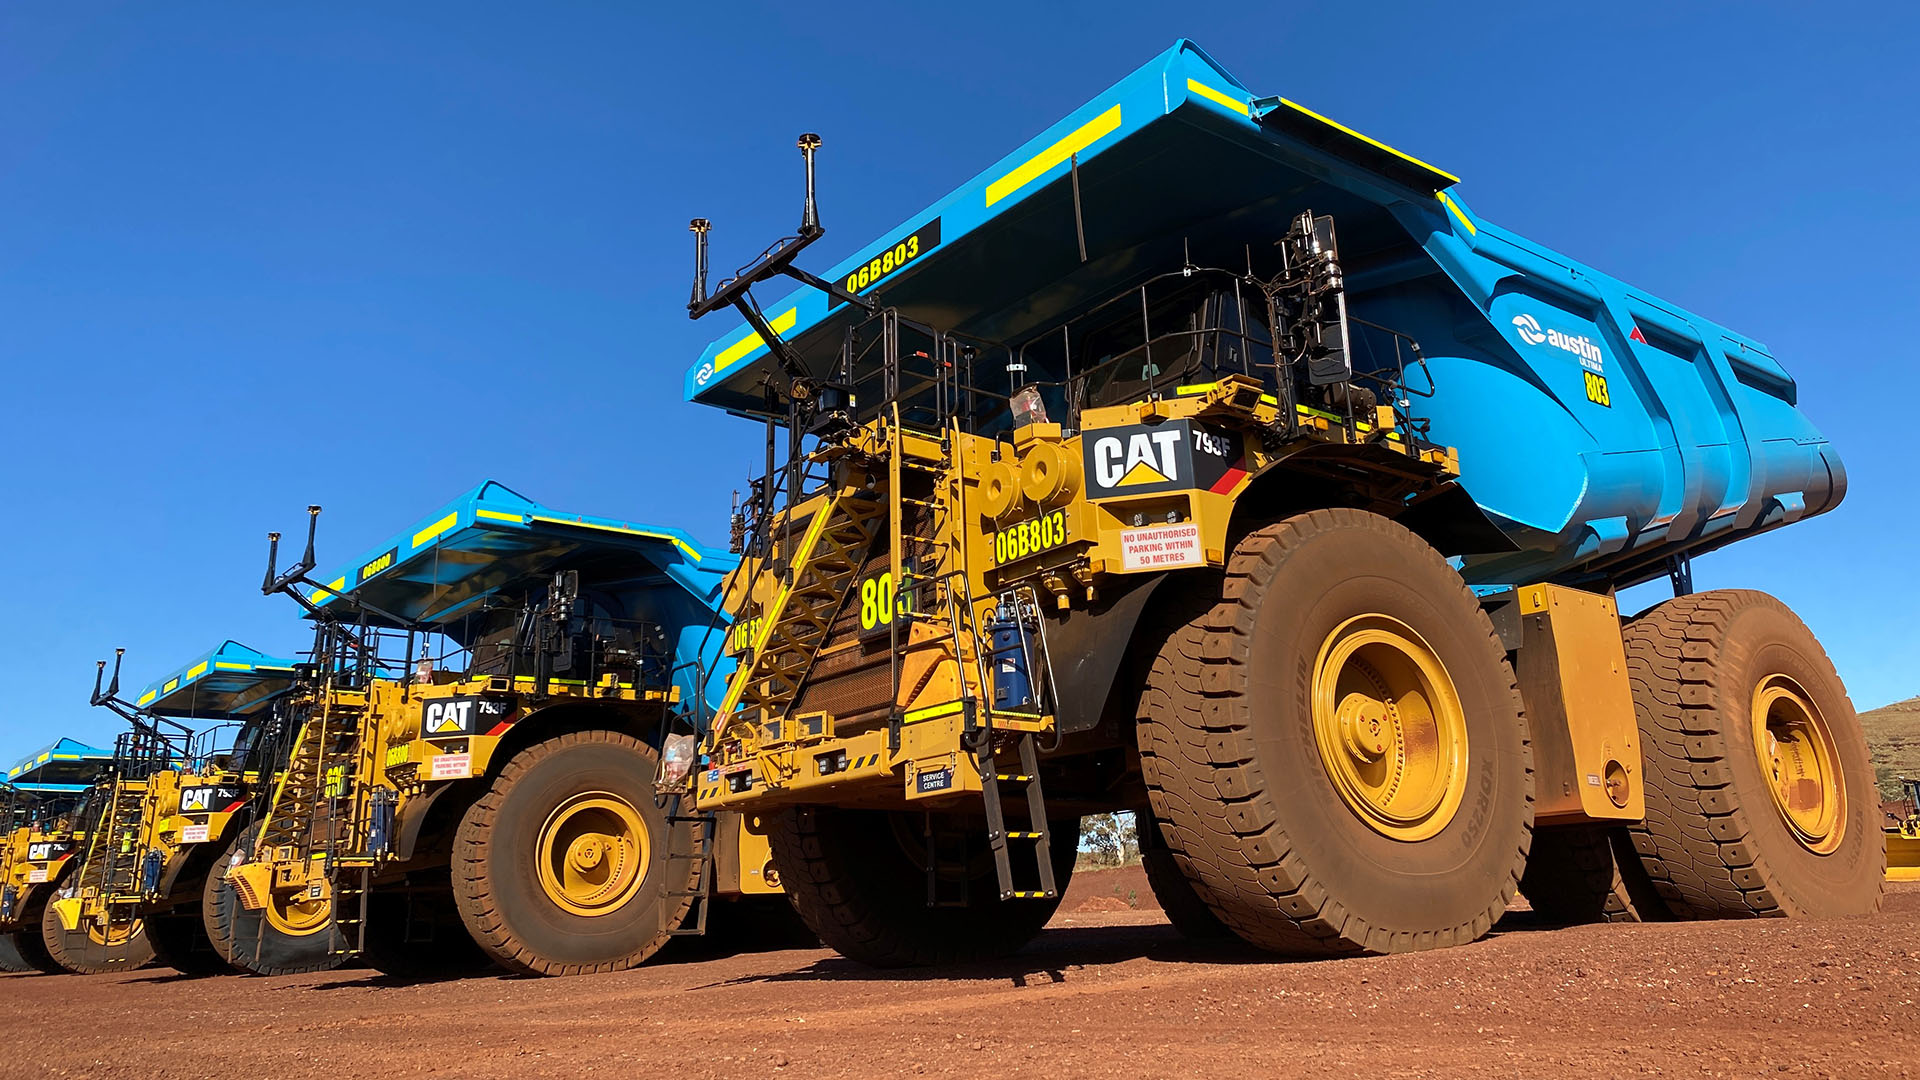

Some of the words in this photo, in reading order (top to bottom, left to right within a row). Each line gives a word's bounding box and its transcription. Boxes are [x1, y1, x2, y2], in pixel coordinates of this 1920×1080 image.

[846, 235, 919, 294] 06B803
[1547, 328, 1603, 364] austin
[1579, 356, 1604, 374] ULTIMA
[1584, 371, 1610, 406] 803
[1192, 429, 1231, 457] 793F
[1094, 430, 1181, 488] CAT
[996, 511, 1065, 564] 06B803
[1124, 533, 1135, 543] NO
[1137, 527, 1197, 542] UNAUTHORISED
[1129, 543, 1163, 554] PARKING
[1165, 540, 1193, 551] WITHIN
[1140, 556, 1151, 565] 50
[1153, 552, 1185, 563] METRES
[426, 701, 471, 733] CAT
[478, 701, 508, 715] 793F
[922, 772, 944, 782] SERVICE
[923, 779, 944, 790] CENTRE
[181, 788, 213, 811] CAT
[29, 843, 51, 860] CAT
